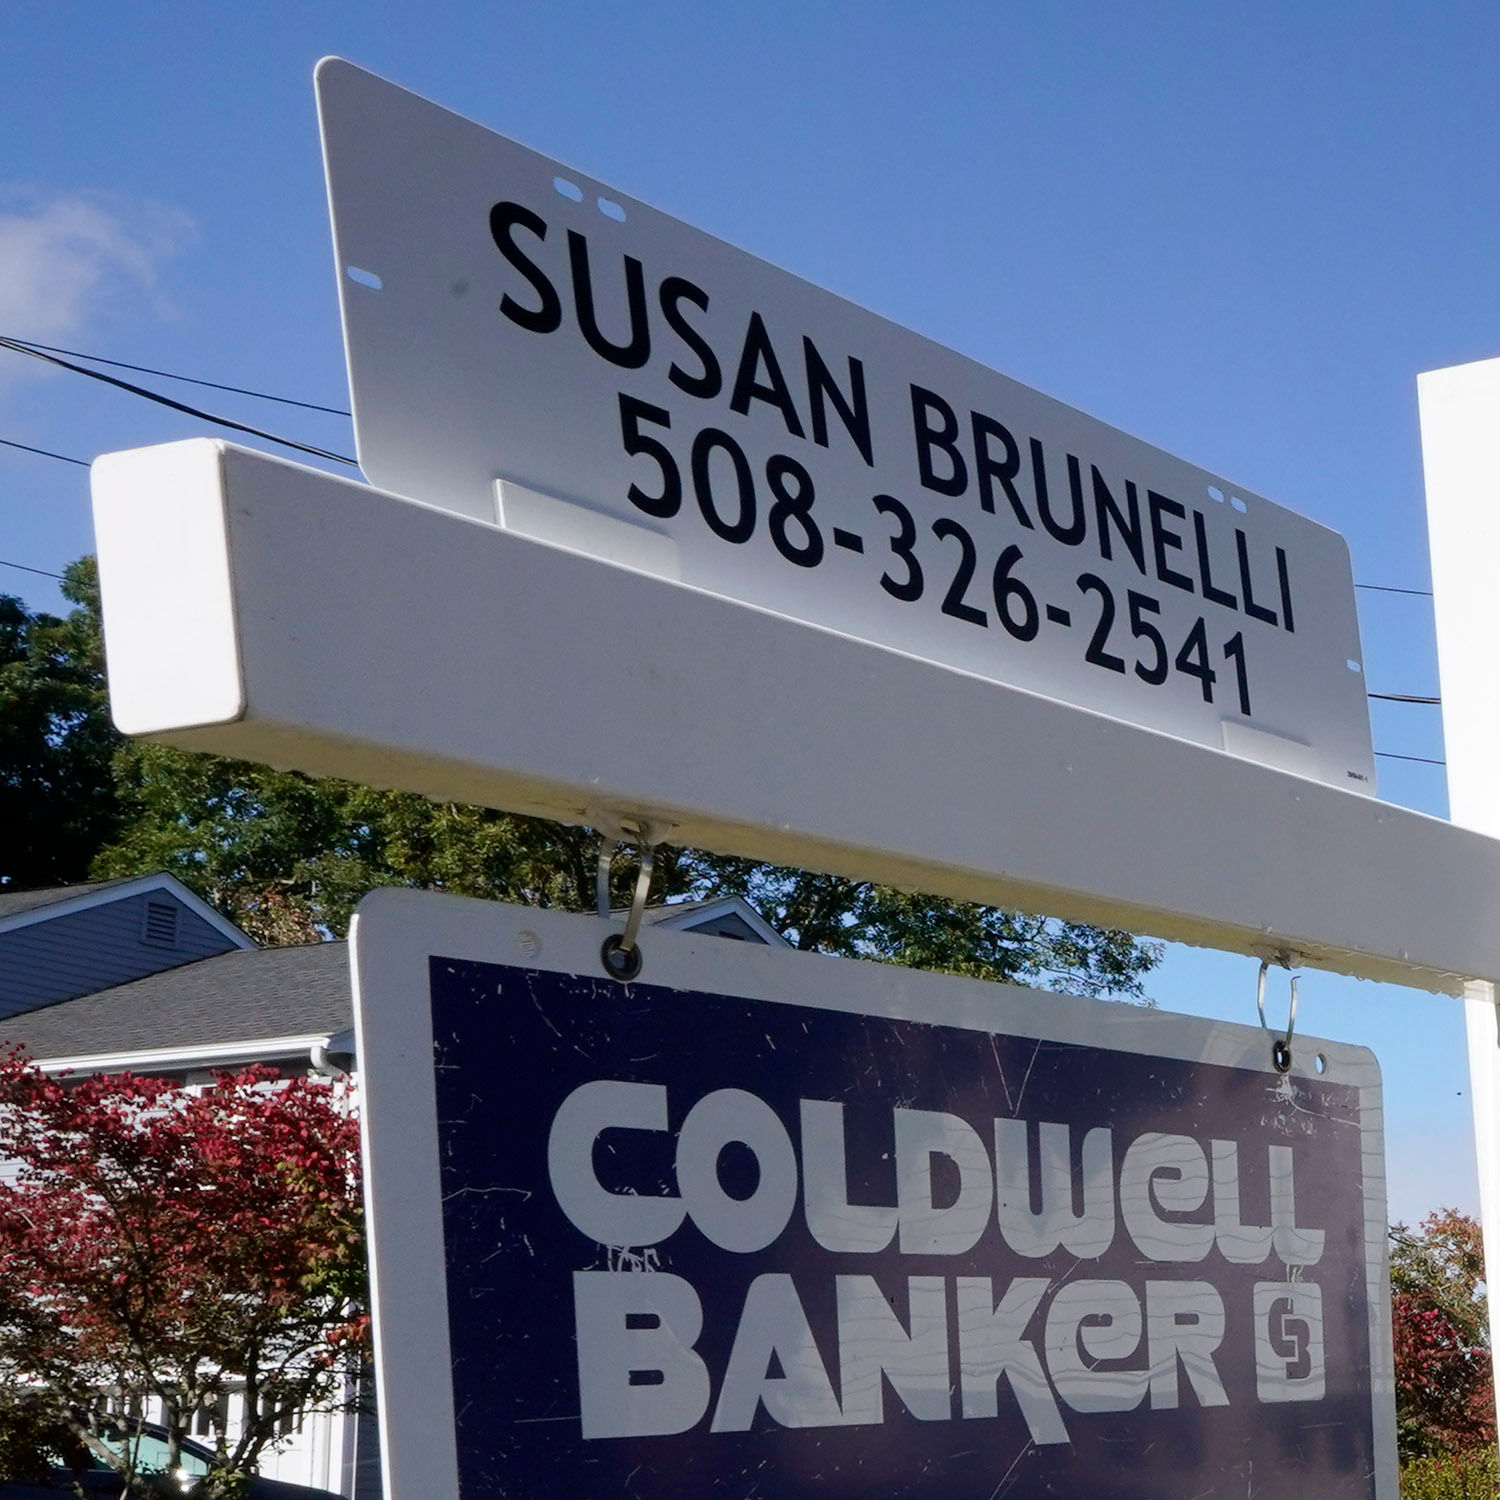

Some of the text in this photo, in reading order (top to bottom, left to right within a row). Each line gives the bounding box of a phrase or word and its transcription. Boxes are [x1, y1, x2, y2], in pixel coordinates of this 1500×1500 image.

[489, 200, 1294, 633] SUSAN BRUNELLI
[618, 392, 1252, 716] 508-326-2541
